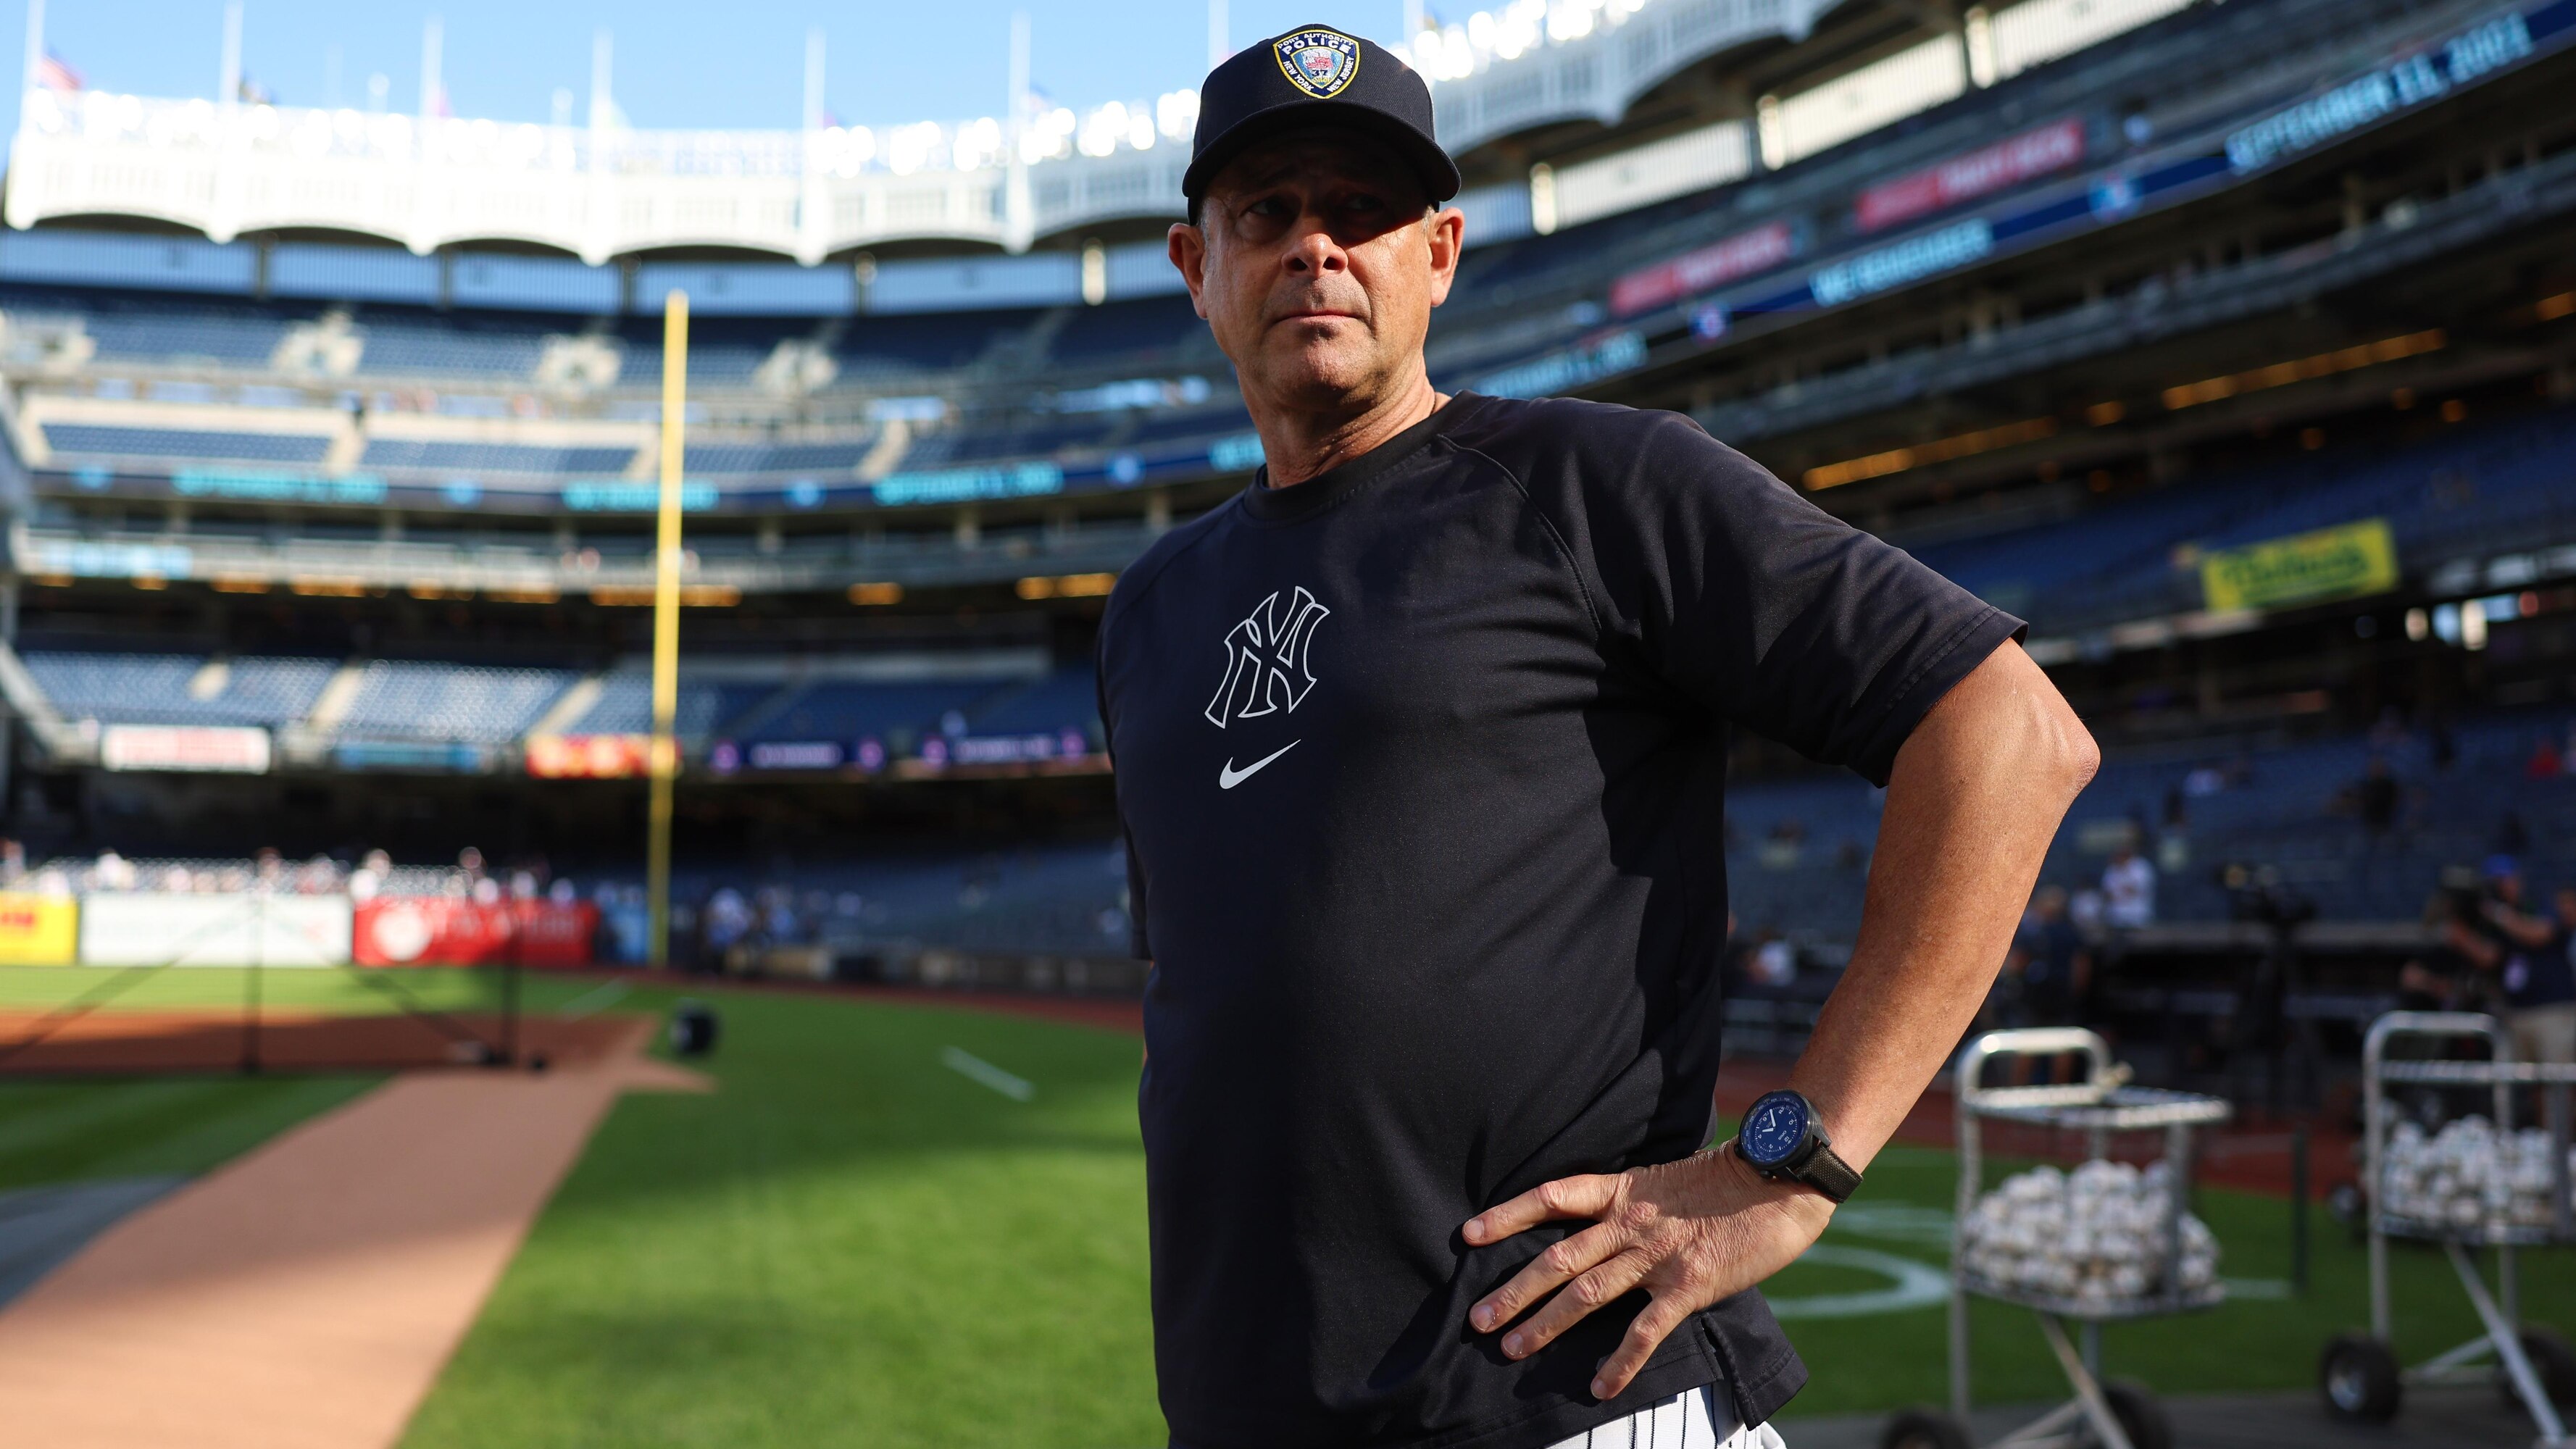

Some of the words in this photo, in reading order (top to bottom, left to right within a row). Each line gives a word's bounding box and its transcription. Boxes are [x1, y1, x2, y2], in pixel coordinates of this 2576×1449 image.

[1277, 36, 1299, 49] PORT
[1304, 33, 1354, 46] AUTHORITY
[1281, 38, 1351, 55] POLICE
[1283, 60, 1298, 75] NEW
[1294, 74, 1314, 92] YORK
[1327, 78, 1343, 93] NEW
[1342, 55, 1355, 80] JERSEY
[2225, 72, 2392, 175] SEPTEMBER
